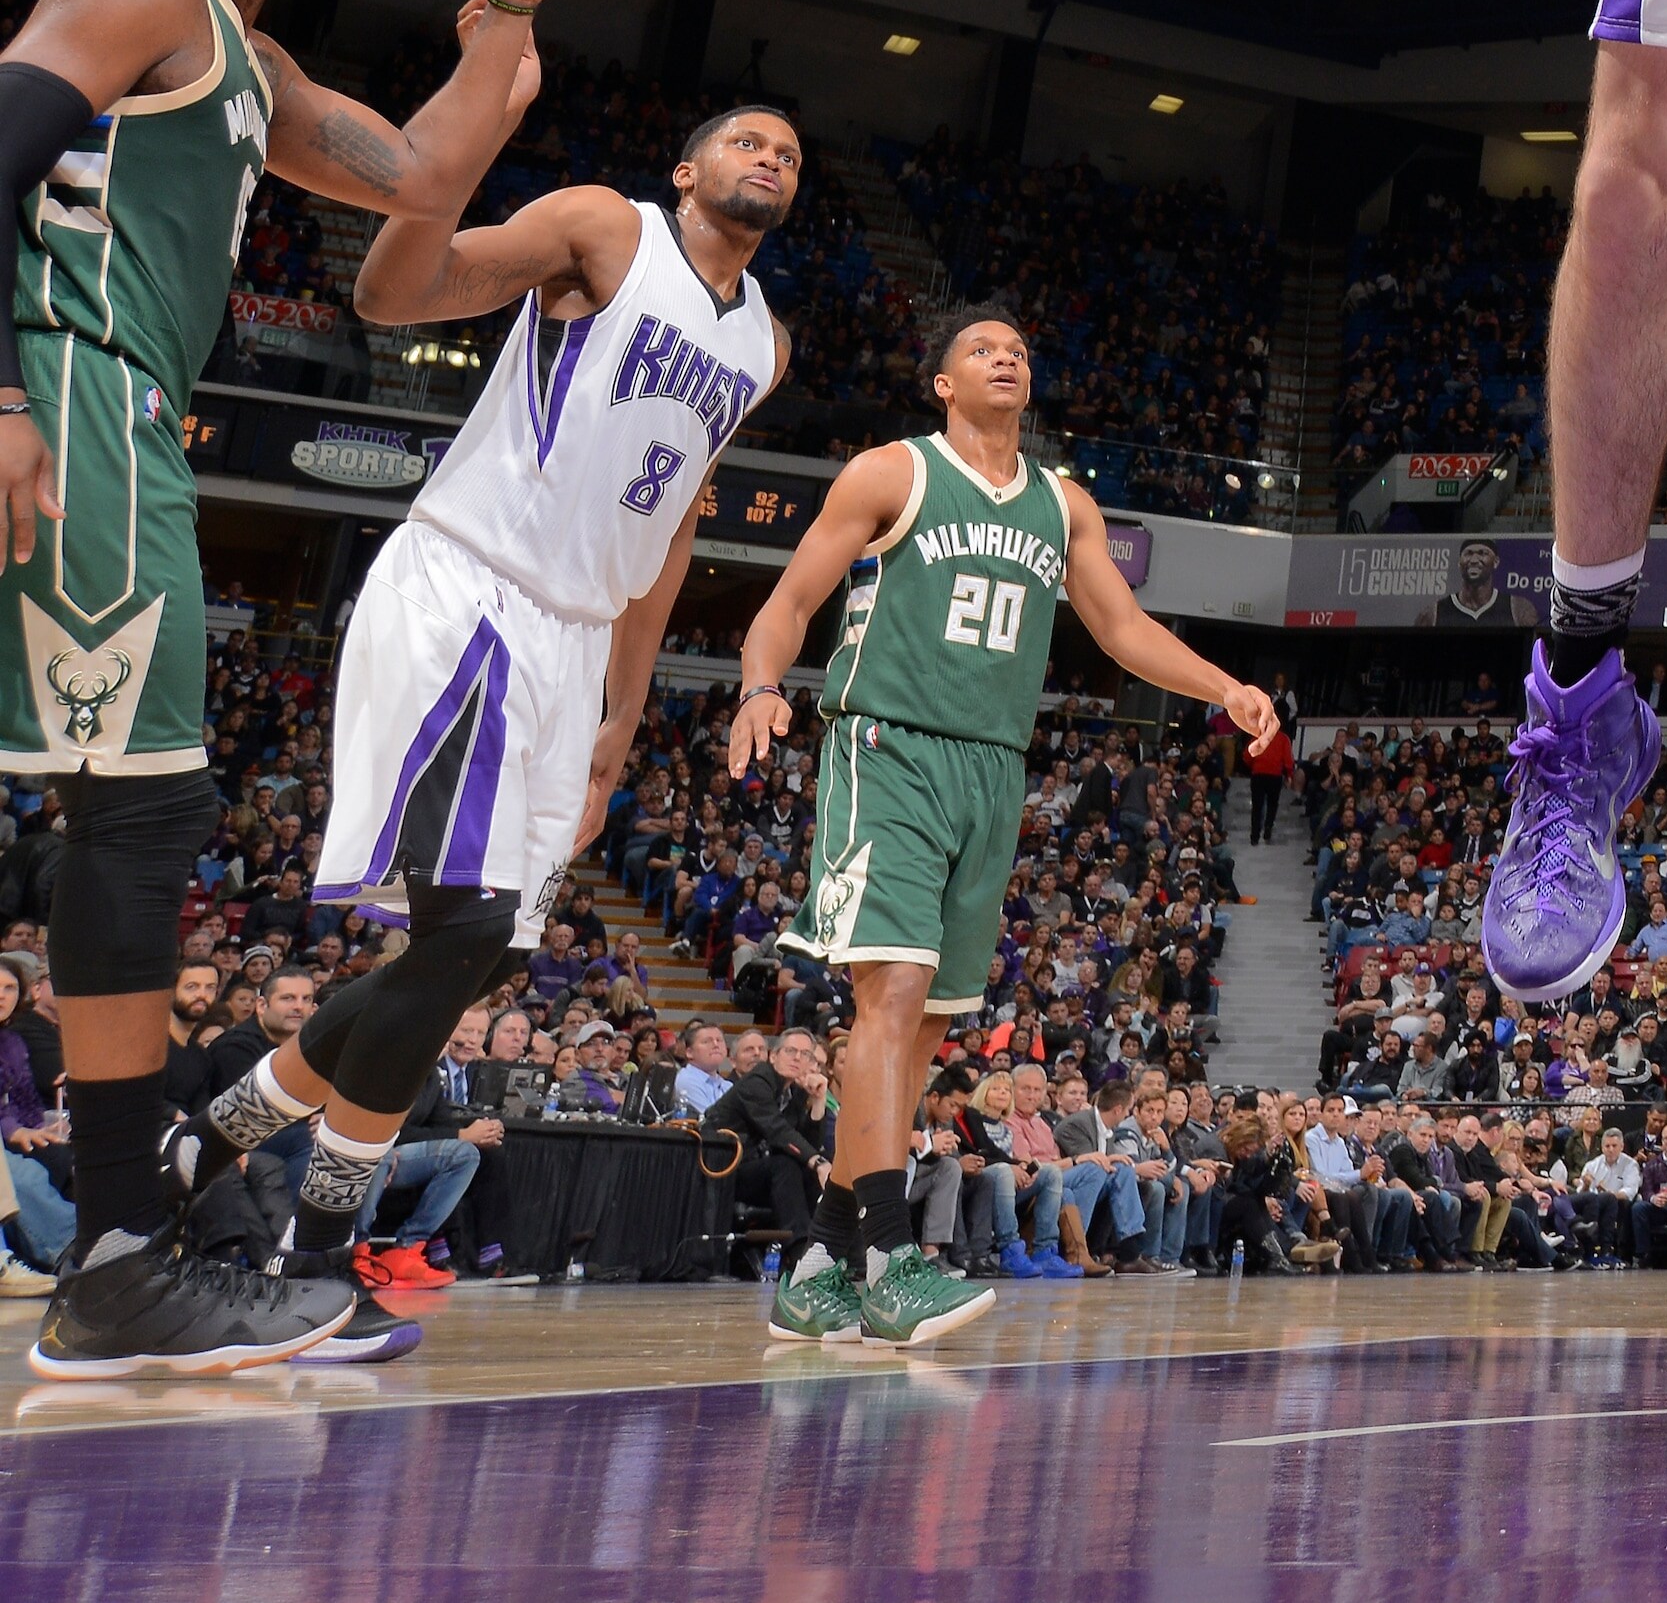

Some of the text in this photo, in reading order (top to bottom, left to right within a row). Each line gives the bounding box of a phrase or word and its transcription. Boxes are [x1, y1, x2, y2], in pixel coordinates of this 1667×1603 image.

[229, 294, 335, 333] 205 206
[610, 313, 759, 463] KINGS
[316, 420, 412, 455] KHTK
[292, 440, 426, 482] SPORTS
[1412, 455, 1493, 477] 206 207
[619, 439, 688, 517] 8
[1438, 481, 1456, 495] EXIT
[745, 502, 798, 525] 107 F
[755, 491, 780, 509] 92
[708, 541, 749, 557] Suite A
[914, 521, 1063, 589] MILWAUKEE
[1338, 548, 1451, 597] 15 DEMARCUS
[1366, 570, 1448, 596] COUSINS
[1506, 571, 1532, 589] Do
[944, 572, 1028, 653] 20
[1309, 611, 1334, 625] 107
